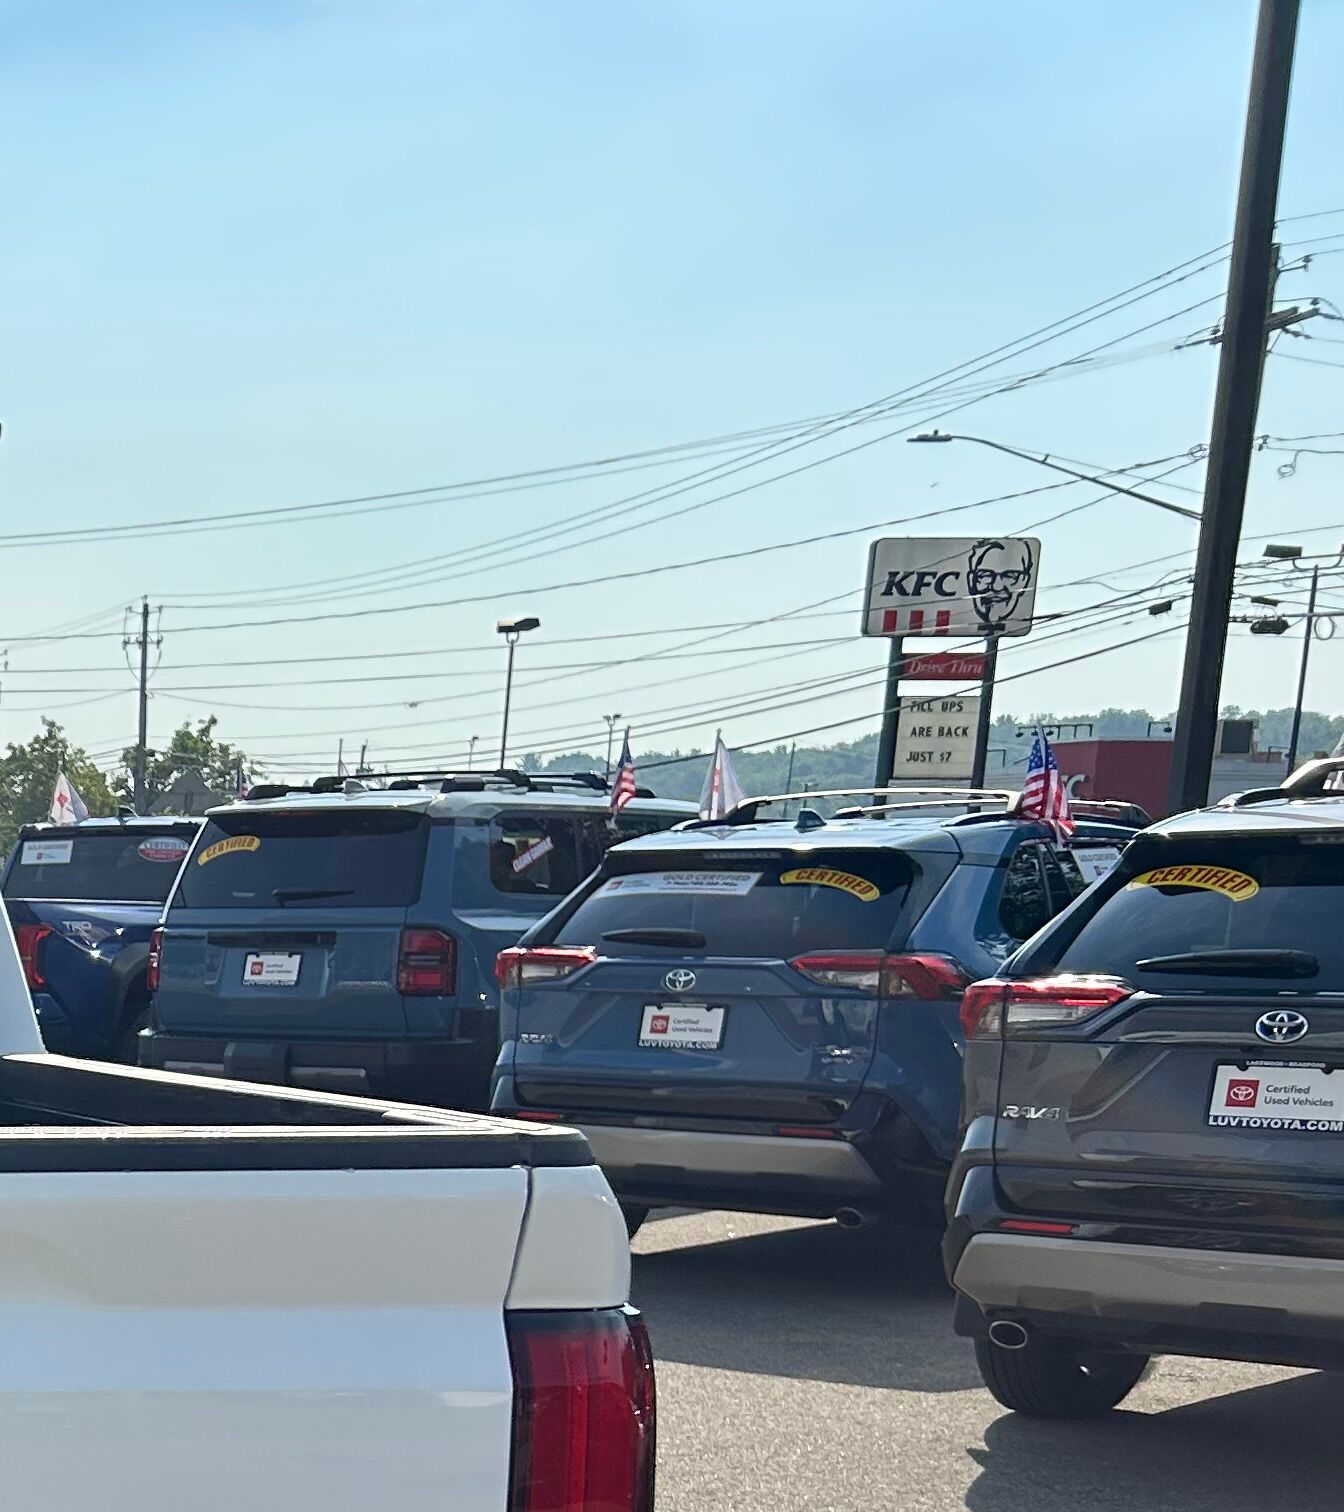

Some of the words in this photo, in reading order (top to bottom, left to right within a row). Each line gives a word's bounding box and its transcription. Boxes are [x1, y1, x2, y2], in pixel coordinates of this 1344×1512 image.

[880, 571, 960, 597] KFC
[949, 660, 983, 674] Thru
[941, 701, 964, 712] UPS
[910, 726, 932, 737] ARE
[938, 726, 969, 737] BACK
[906, 751, 934, 762] JUST
[939, 751, 952, 762] $7
[206, 837, 256, 858] CERTIFIED
[795, 869, 875, 895] CERTIFIED
[1147, 867, 1253, 893] CERTIFIED
[1266, 1084, 1311, 1095] Certified
[1264, 1096, 1290, 1105] Used
[1292, 1097, 1334, 1107] Vehicles
[1208, 1116, 1344, 1132] LUVTOYOTA.COM
